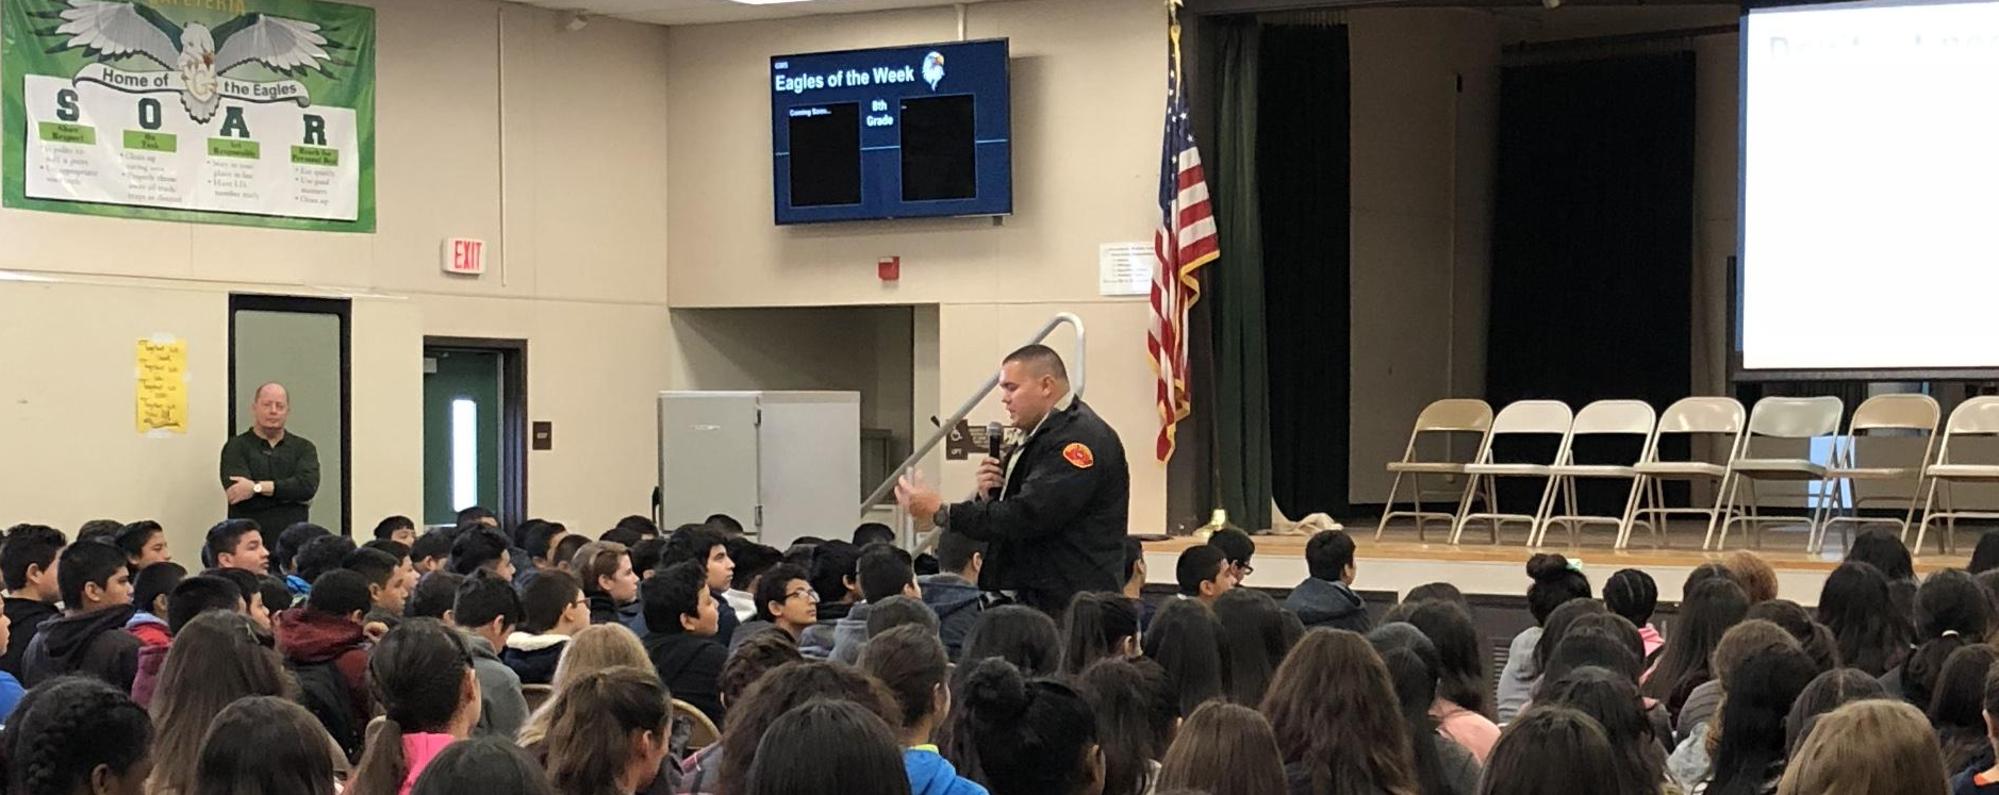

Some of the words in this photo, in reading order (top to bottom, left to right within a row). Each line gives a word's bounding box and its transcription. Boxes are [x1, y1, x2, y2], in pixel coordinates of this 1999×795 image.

[102, 67, 149, 87] Home
[153, 73, 169, 87] of
[224, 81, 250, 95] the
[253, 84, 297, 99] Eagles
[775, 73, 825, 94] Eagles
[827, 70, 844, 87] of
[846, 69, 870, 86] the
[872, 65, 916, 84] Week
[56, 88, 80, 122] S
[138, 97, 162, 130] O
[220, 106, 250, 138] A
[303, 114, 327, 146] R
[872, 99, 888, 111] 8th
[866, 114, 894, 127] Grade
[455, 240, 482, 270] EXIT
